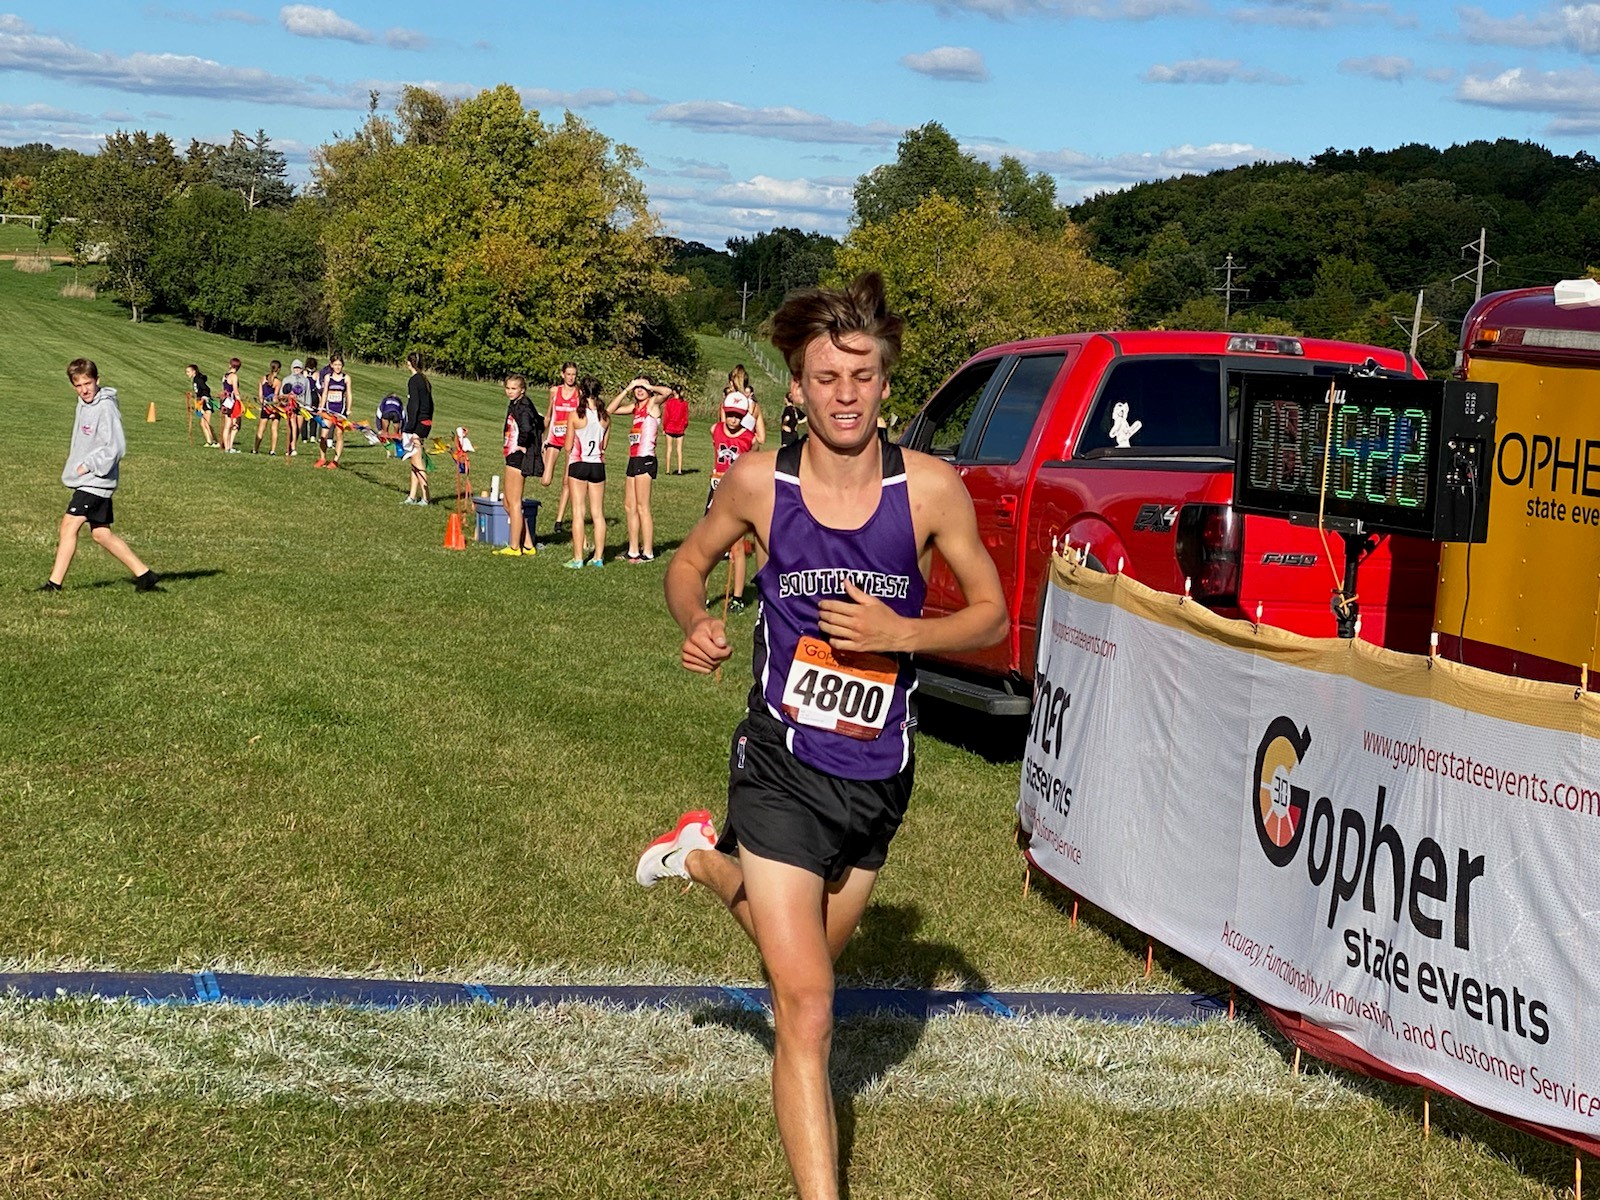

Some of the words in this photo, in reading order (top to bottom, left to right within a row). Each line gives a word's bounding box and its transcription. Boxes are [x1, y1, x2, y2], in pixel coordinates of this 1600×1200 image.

[1497, 432, 1600, 498] OPHE
[1135, 503, 1179, 526] FX4
[1526, 496, 1566, 521] state
[1571, 505, 1600, 526] eve
[779, 568, 909, 598] SOUTHWEST
[793, 668, 884, 723] 4800
[1274, 776, 1288, 807] 30
[1363, 730, 1600, 817] www.gopherstateevents.com
[1253, 716, 1485, 950] Gopher
[1343, 927, 1409, 994] state
[1417, 962, 1550, 1045] events
[1221, 921, 1263, 967] Accuracy,
[1262, 944, 1323, 1006] Functionality,
[1403, 1024, 1436, 1050] and
[1441, 1030, 1526, 1088] Customer
[1530, 1066, 1600, 1117] Service
